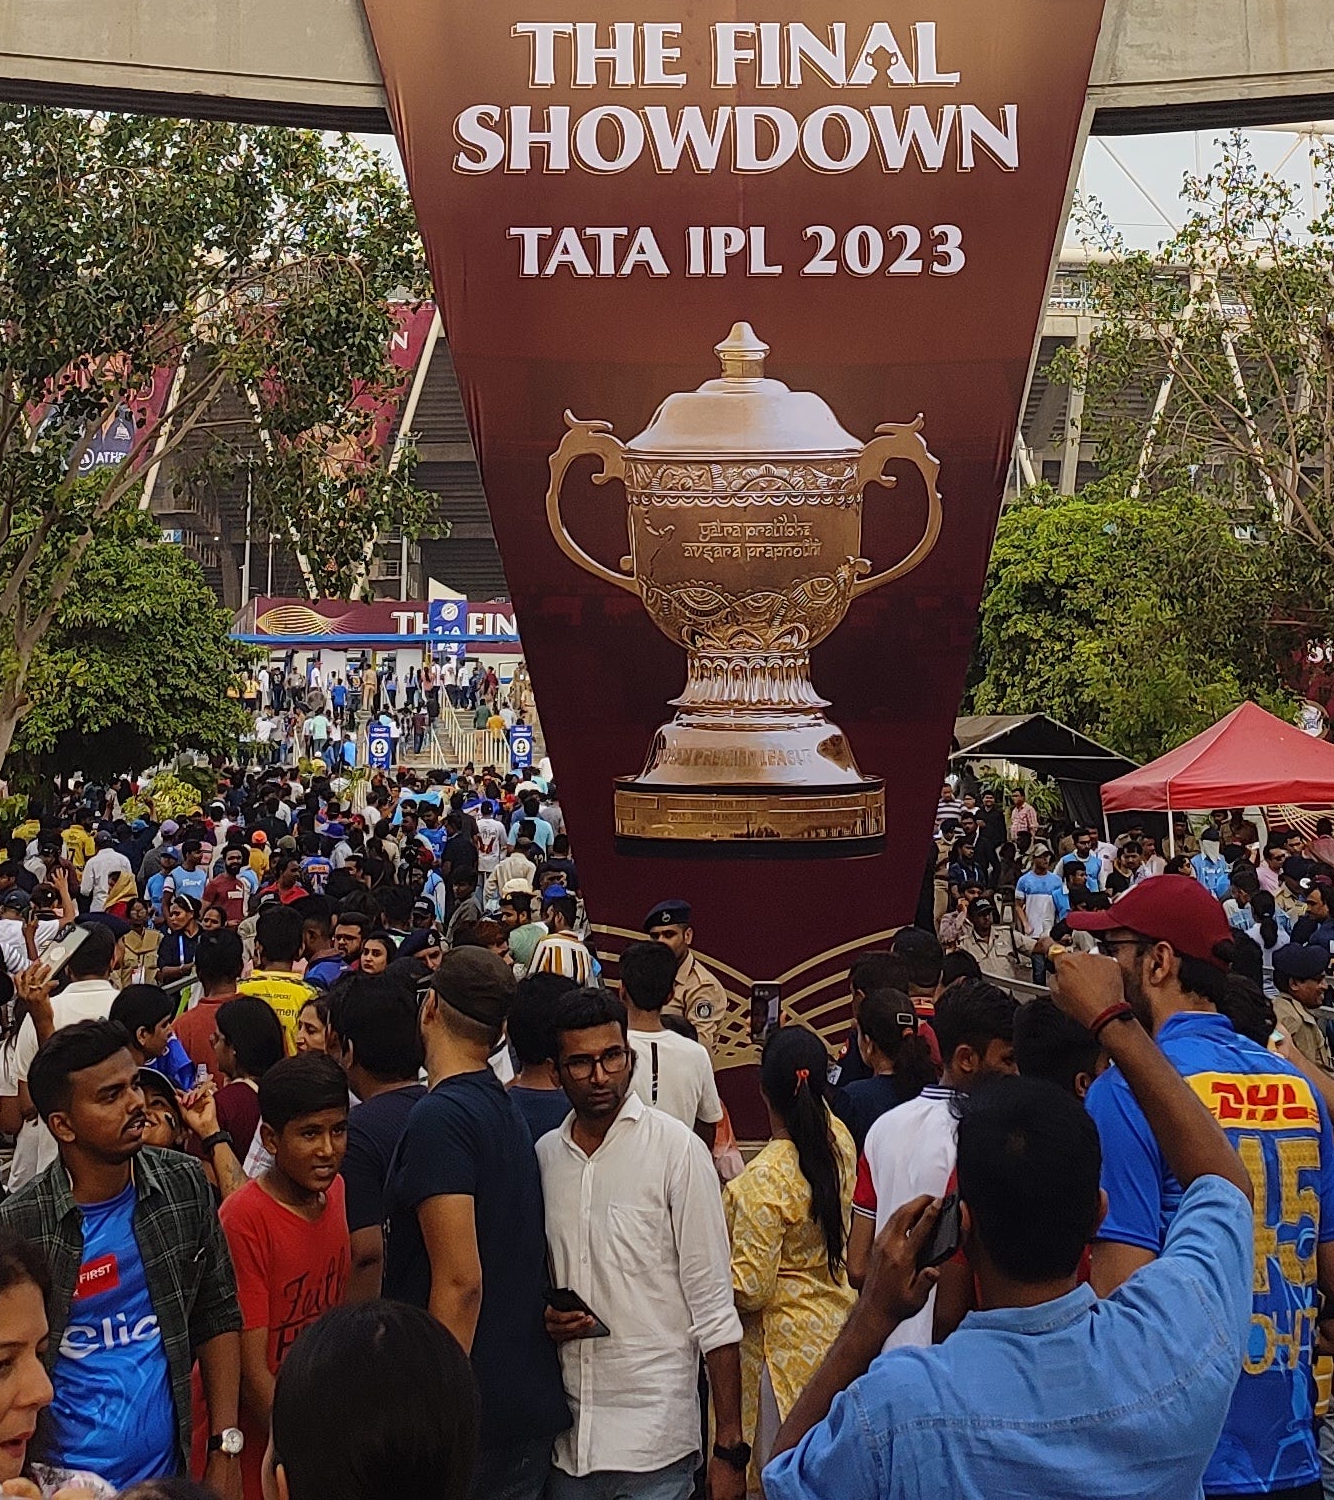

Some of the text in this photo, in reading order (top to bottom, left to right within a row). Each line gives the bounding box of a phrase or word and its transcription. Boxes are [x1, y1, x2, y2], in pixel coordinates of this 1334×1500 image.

[511, 20, 962, 90] THE FINAL
[451, 103, 1021, 176] SHOWDOWN
[508, 224, 967, 277] TATA IPL 2023
[95, 451, 130, 464] ATH
[390, 611, 517, 636] TH FIN
[1211, 1081, 1309, 1122] DHL
[78, 1263, 113, 1285] FIRST
